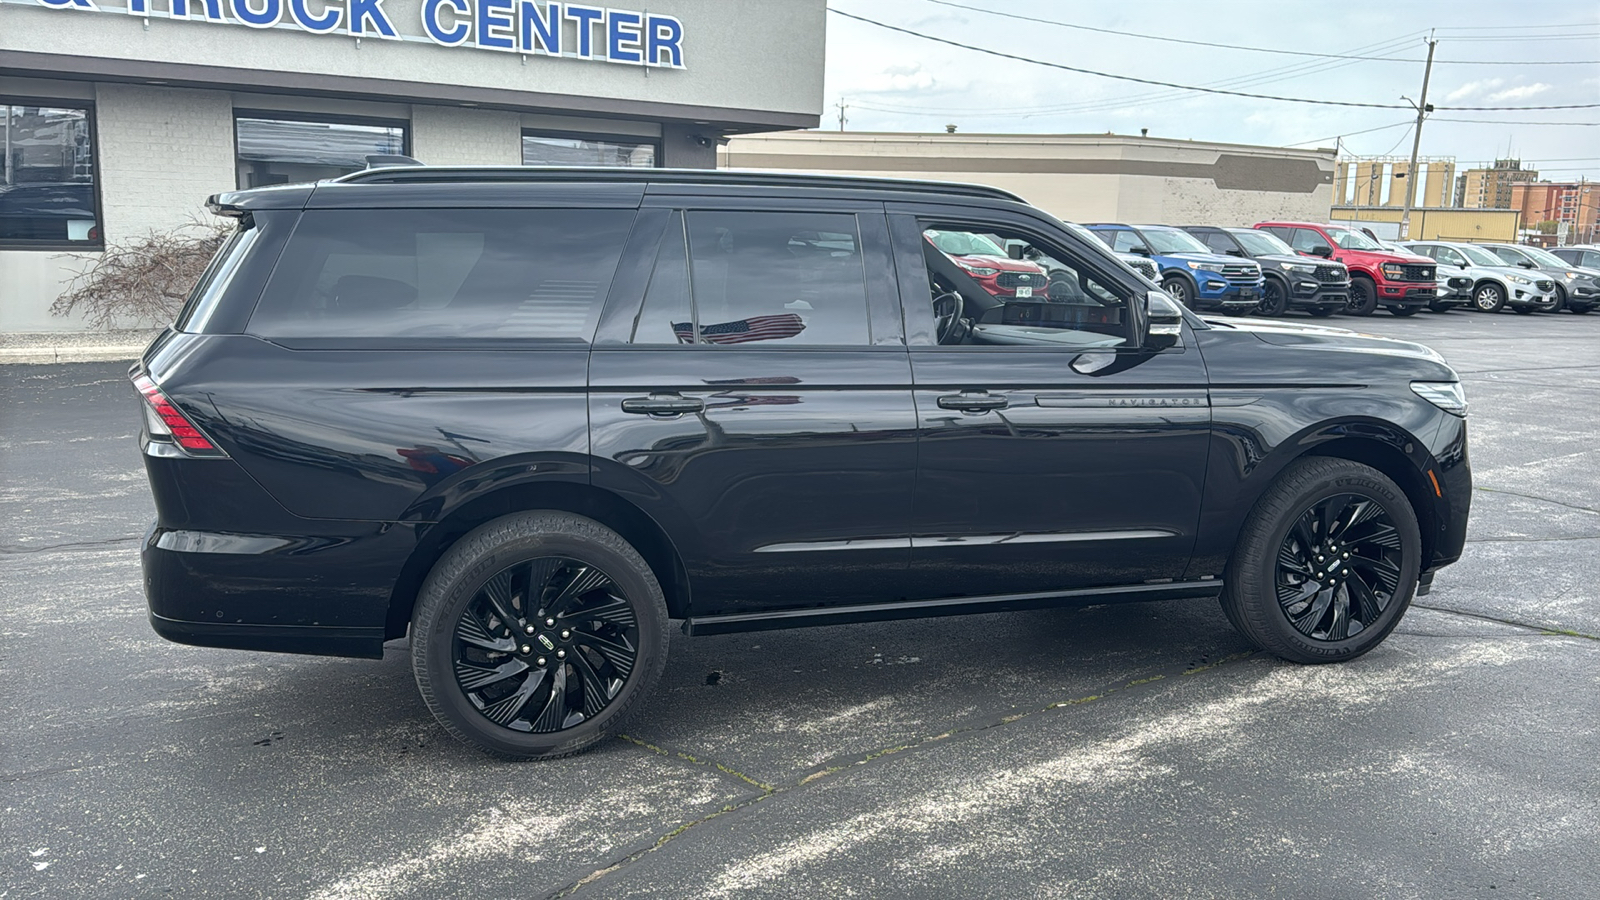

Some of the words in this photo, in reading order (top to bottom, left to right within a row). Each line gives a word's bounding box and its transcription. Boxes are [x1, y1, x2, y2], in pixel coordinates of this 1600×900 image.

[421, 0, 687, 70] CENTER
[1108, 398, 1200, 406] NAVIGATOR
[1349, 478, 1394, 500] MICHELIN
